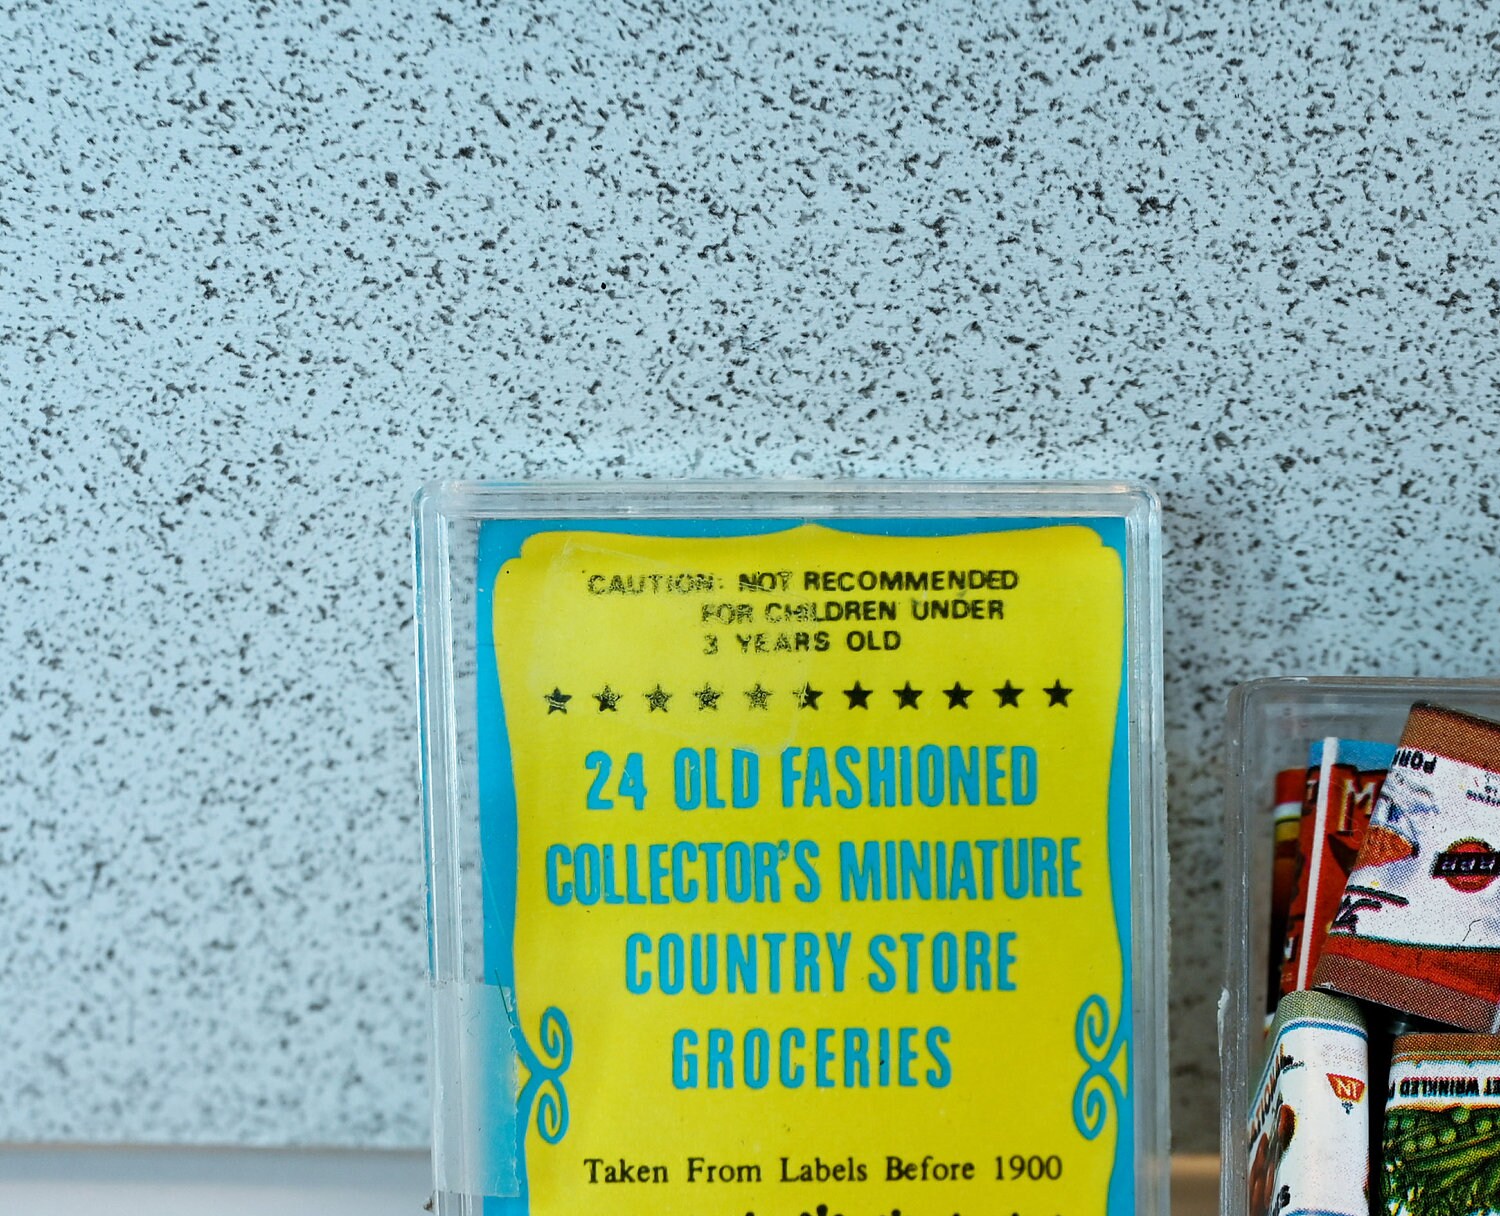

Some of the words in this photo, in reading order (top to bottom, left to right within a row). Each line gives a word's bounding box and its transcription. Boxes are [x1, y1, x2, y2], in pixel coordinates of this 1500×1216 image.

[588, 574, 722, 594] CAUTION:
[739, 572, 792, 592] NOT
[804, 570, 1019, 591] RECOMMENDED
[702, 604, 753, 624] FOR
[765, 601, 896, 623] CHILDREN
[912, 599, 1003, 620] UNDER
[705, 635, 718, 654] 3
[737, 631, 830, 653] YEARS
[846, 630, 903, 652] OLD
[585, 750, 648, 811] 24
[674, 747, 760, 811] OLD
[781, 744, 1038, 809] FASHIONED
[545, 839, 821, 906] COLLECTOR'S
[839, 837, 1083, 902] MINIATURE
[626, 932, 852, 995] COUNTRY
[868, 931, 1017, 994] STORE
[672, 1026, 952, 1090] GROCERIES
[1400, 1076, 1480, 1099] WRINKLED
[584, 1159, 668, 1183] Taken
[688, 1158, 761, 1182] From
[781, 1157, 867, 1182] Labels
[886, 1156, 974, 1181] Before
[996, 1155, 1062, 1180] 1900
